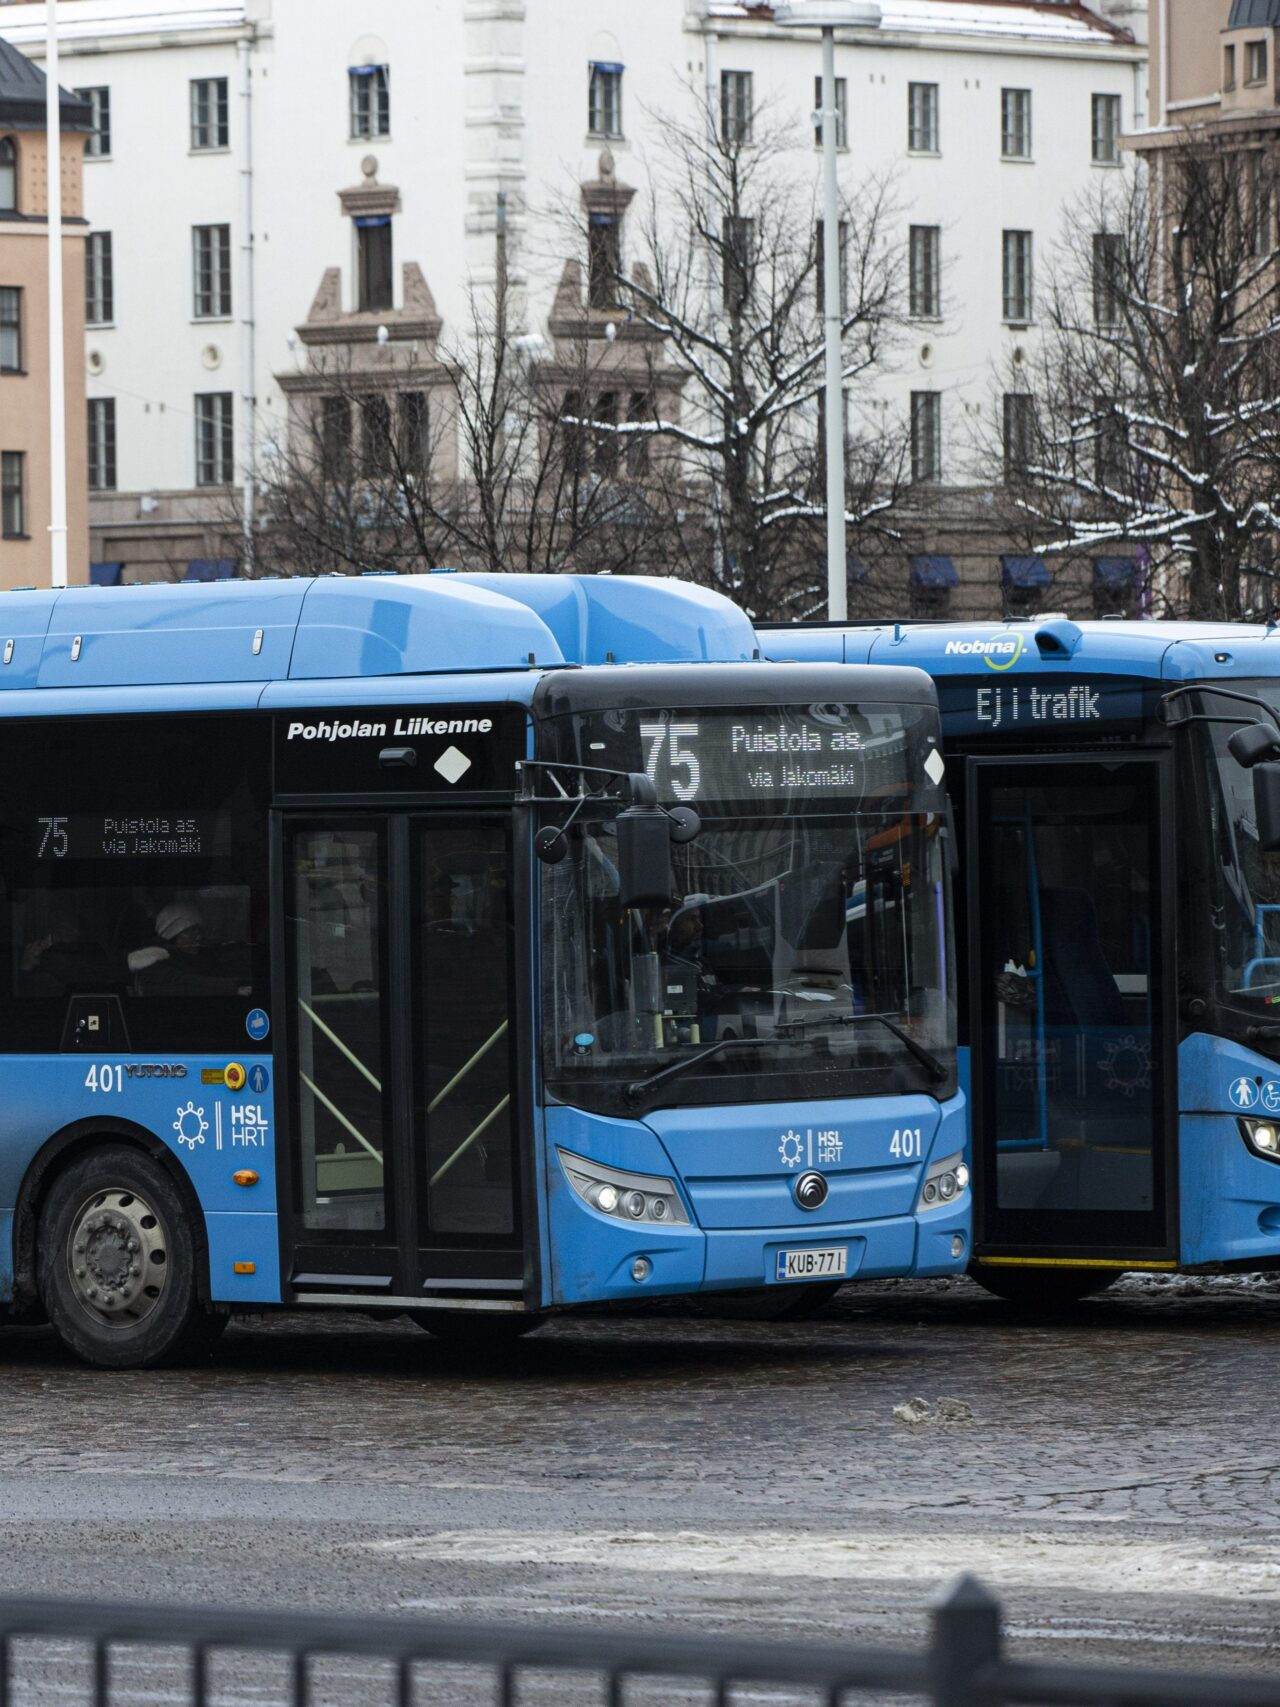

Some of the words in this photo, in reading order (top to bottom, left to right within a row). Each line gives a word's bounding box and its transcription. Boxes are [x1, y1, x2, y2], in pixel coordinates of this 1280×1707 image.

[977, 688, 1002, 727] Ej
[1013, 687, 1018, 719] i
[1030, 686, 1100, 719] trafik
[287, 720, 386, 741] Pohjolan
[393, 718, 493, 736] Liikenne
[732, 725, 821, 752] Puistola
[830, 732, 866, 750] as.
[640, 724, 700, 800] 75
[748, 767, 774, 787] via
[780, 765, 854, 786] Jakomäki
[38, 817, 68, 857] 75
[104, 818, 170, 834] Puistola
[176, 820, 199, 833] as.
[102, 838, 126, 854] via
[132, 837, 201, 853] Jakomäki
[85, 1064, 122, 1092] 401
[124, 1063, 188, 1079] YUTONG
[231, 1105, 268, 1125] HSL
[232, 1127, 268, 1146] HRT
[818, 1130, 843, 1146] HSL
[889, 1129, 921, 1158] 401
[818, 1146, 843, 1163] HRT
[788, 1252, 841, 1274] KUB-771
